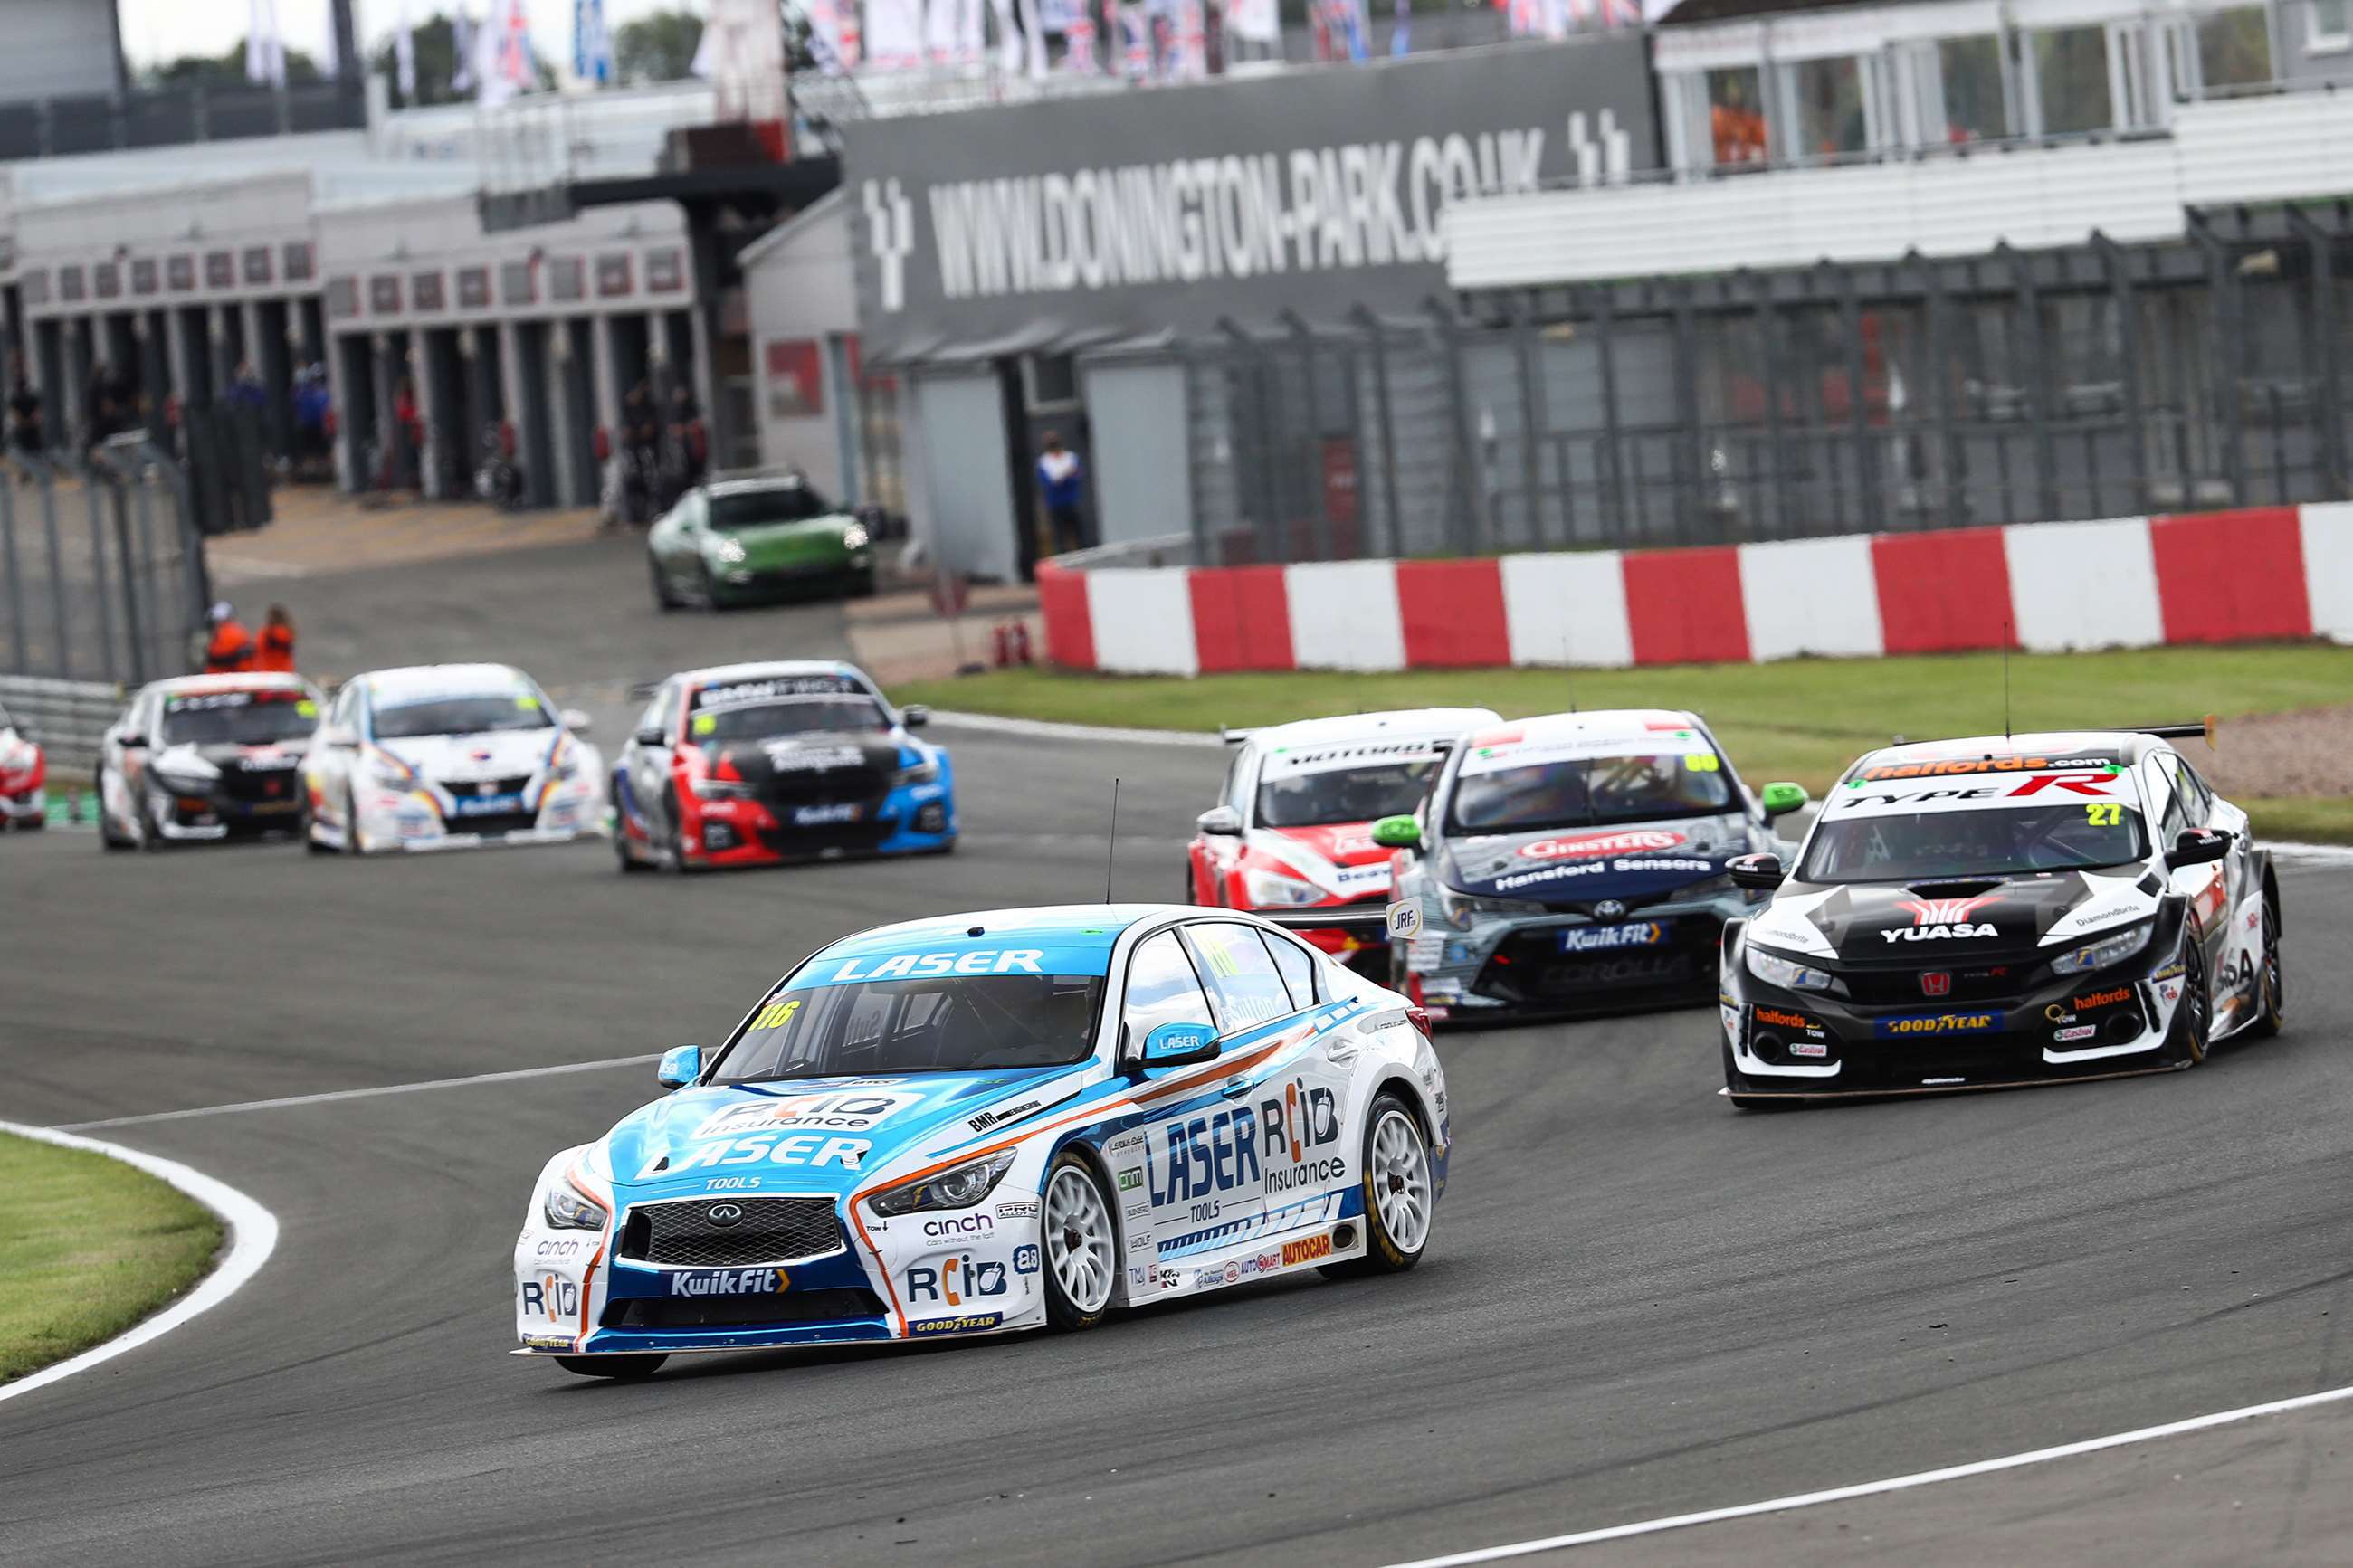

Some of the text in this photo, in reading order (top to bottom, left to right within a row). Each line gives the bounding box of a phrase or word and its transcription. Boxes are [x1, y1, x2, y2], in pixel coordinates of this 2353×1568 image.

[928, 128, 1546, 299] WWW.DONINGTON-PARK.COUK
[1864, 755, 2111, 783] halfords.com
[1842, 774, 2120, 809] TYPE R
[2086, 803, 2122, 826] 27
[1520, 830, 1678, 860] GINSTERS
[1495, 858, 1712, 892] Hansford Sensors
[1396, 909, 1414, 930] JRF
[1881, 922, 2000, 944] YUASA
[830, 948, 1044, 983] LASER
[2073, 987, 2131, 1011] halfords
[747, 999, 803, 1033] 116
[1756, 1006, 1807, 1029] halfords
[1887, 1013, 1992, 1033] GOODYEAR
[1159, 1035, 1201, 1050] LASER
[1805, 1029, 1826, 1039] TOW
[700, 1117, 871, 1137] Insurance
[967, 1111, 999, 1133] BMR
[634, 1134, 874, 1181] LASER
[1143, 1106, 1261, 1209] LASER
[706, 1176, 762, 1192] TOOLS
[1264, 1156, 1347, 1194] Insurance
[1190, 1200, 1221, 1223] TOOLS
[923, 1213, 994, 1237] cinch
[537, 1239, 579, 1257] cinch
[1282, 1233, 1332, 1267] AUTOCAR
[916, 1316, 996, 1333] GOODYEAR
